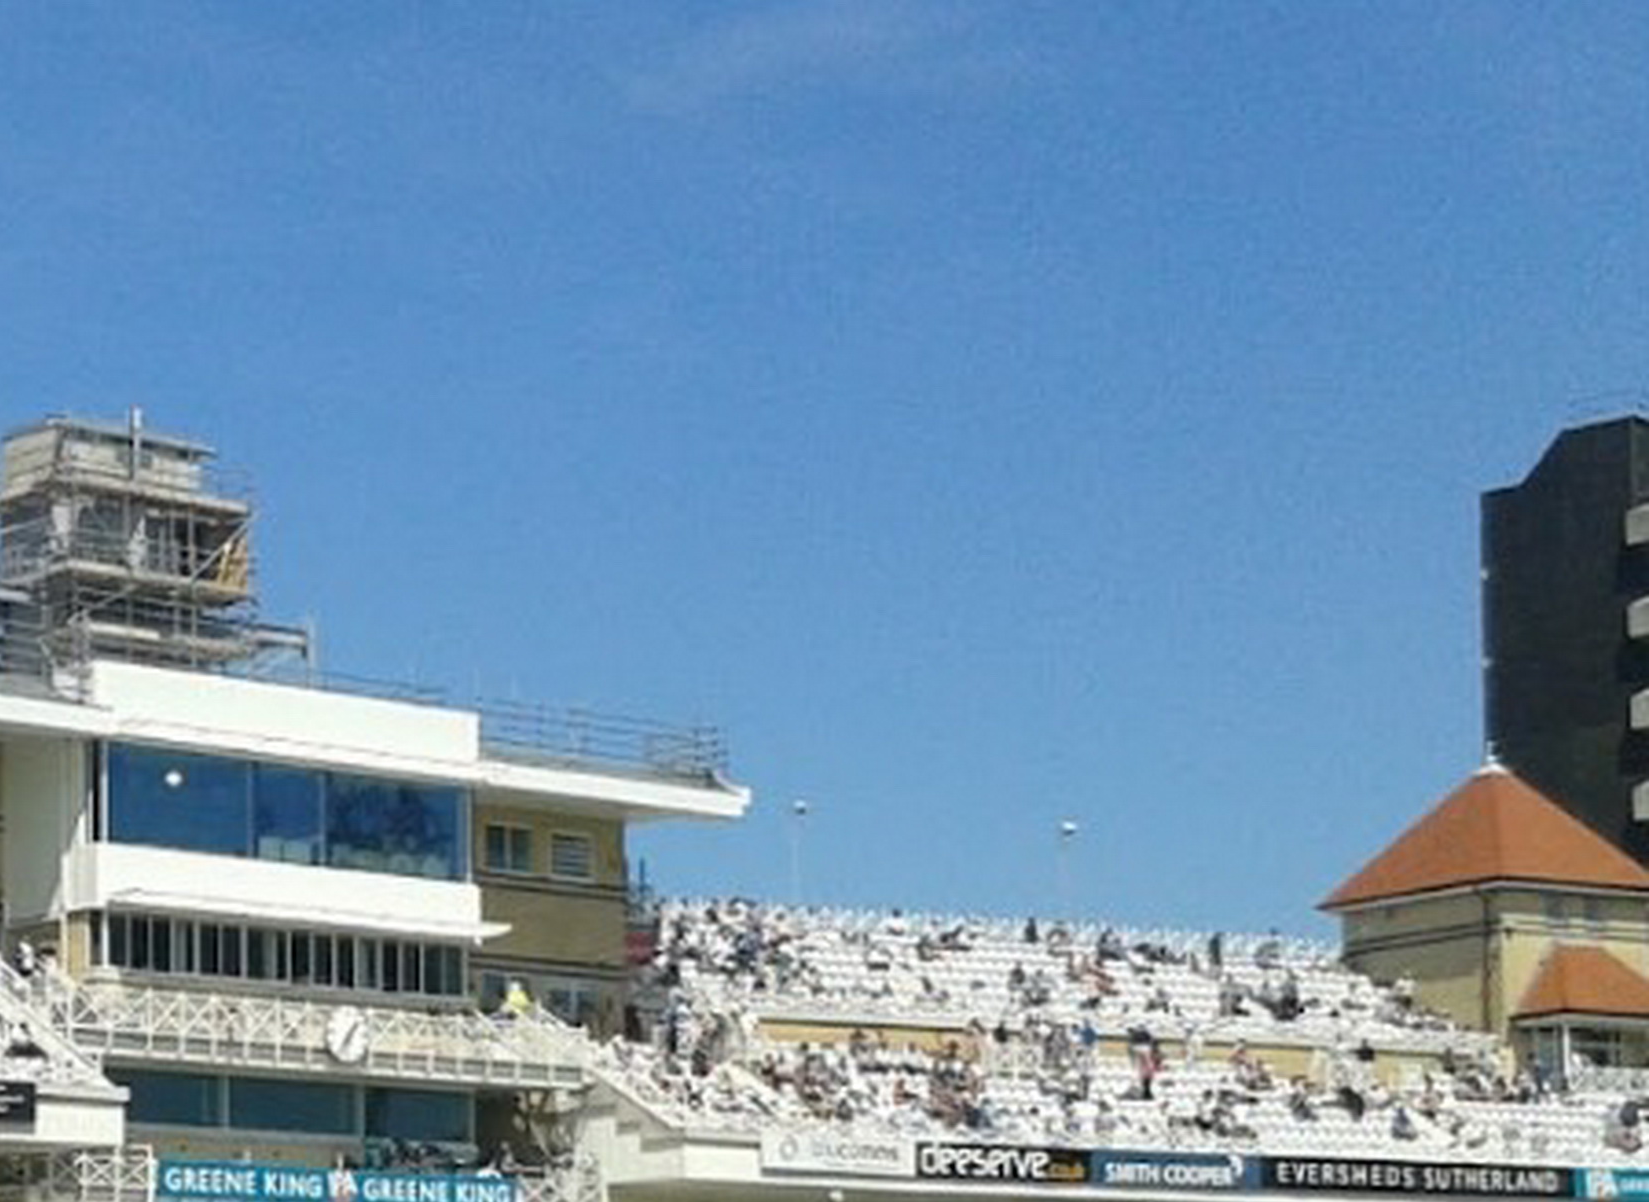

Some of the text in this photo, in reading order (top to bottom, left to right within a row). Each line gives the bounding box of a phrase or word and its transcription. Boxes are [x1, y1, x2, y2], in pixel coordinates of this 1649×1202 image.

[164, 1166, 257, 1195] GREENE
[263, 1170, 324, 1199] KING
[1104, 1162, 1159, 1184] SMITH
[1163, 1163, 1234, 1187] COOPER
[1276, 1162, 1560, 1193] EVERSHEDS SUTHERLAND
